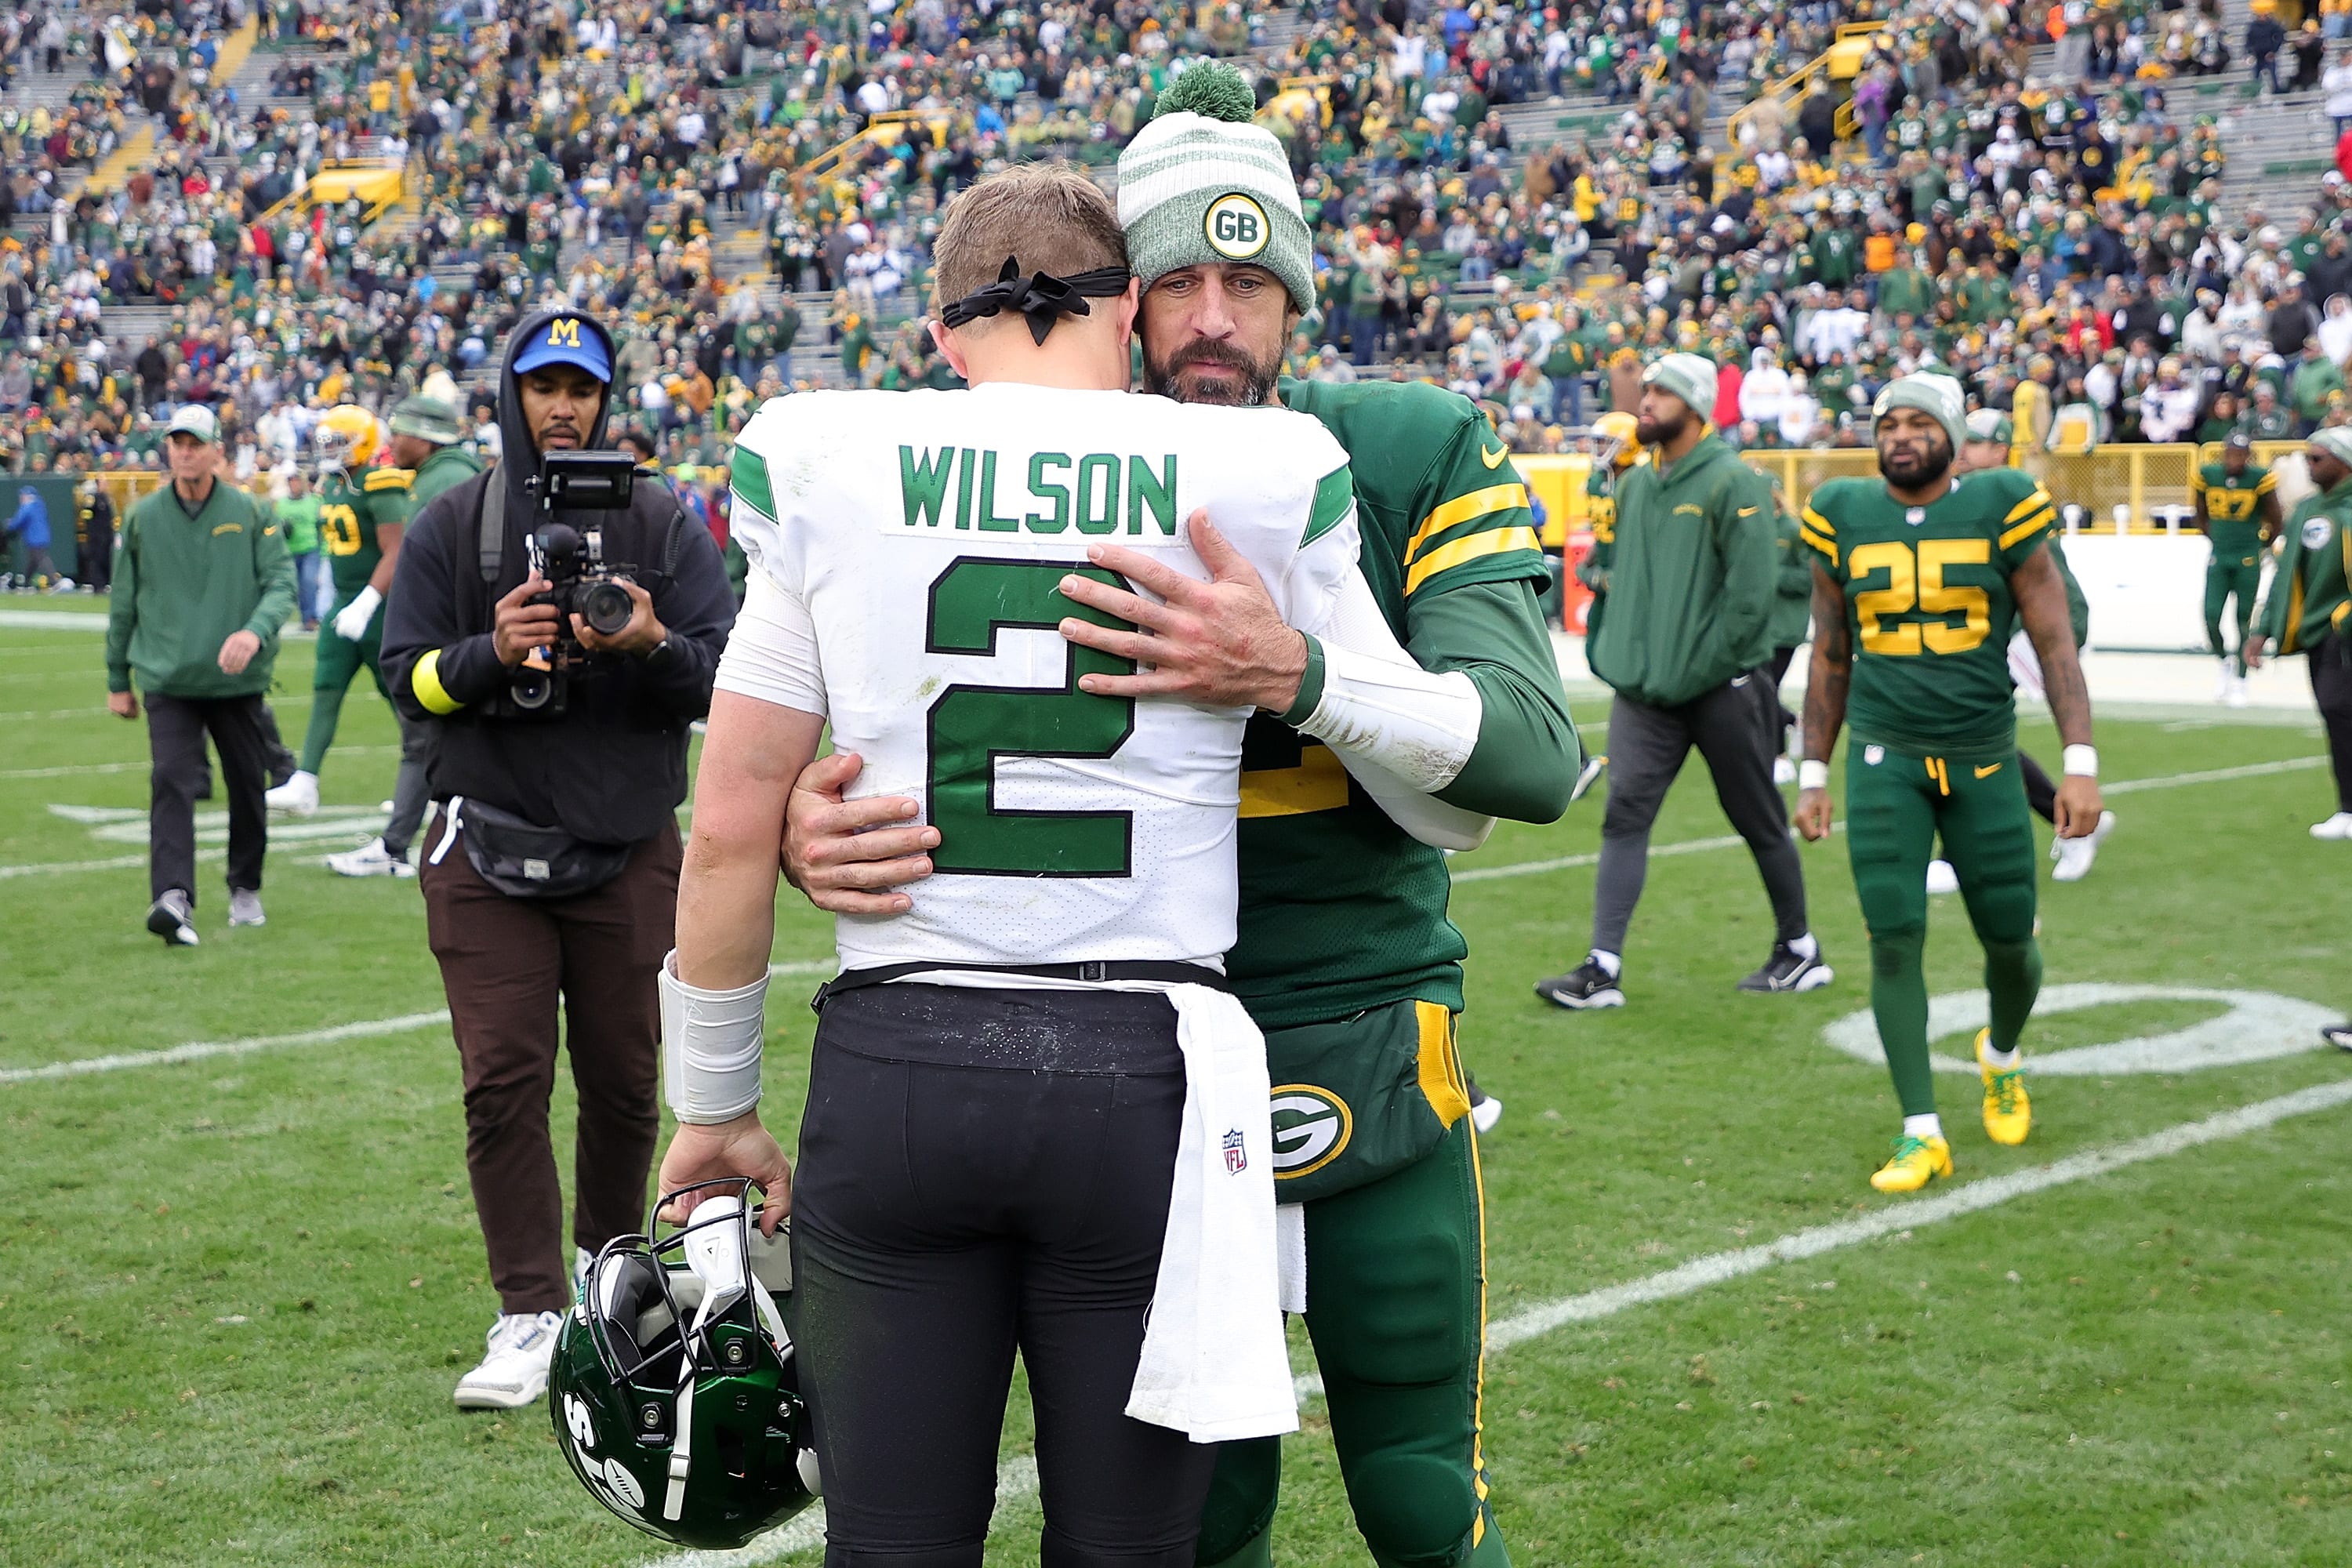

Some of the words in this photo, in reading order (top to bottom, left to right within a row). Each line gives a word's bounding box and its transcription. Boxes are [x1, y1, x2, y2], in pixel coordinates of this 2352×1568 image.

[1215, 209, 1258, 242] GB
[547, 318, 581, 348] M
[898, 445, 1178, 535] WILSON
[1848, 539, 1991, 655] 25
[925, 555, 1139, 878] 2
[1224, 1149, 1244, 1172] NFL
